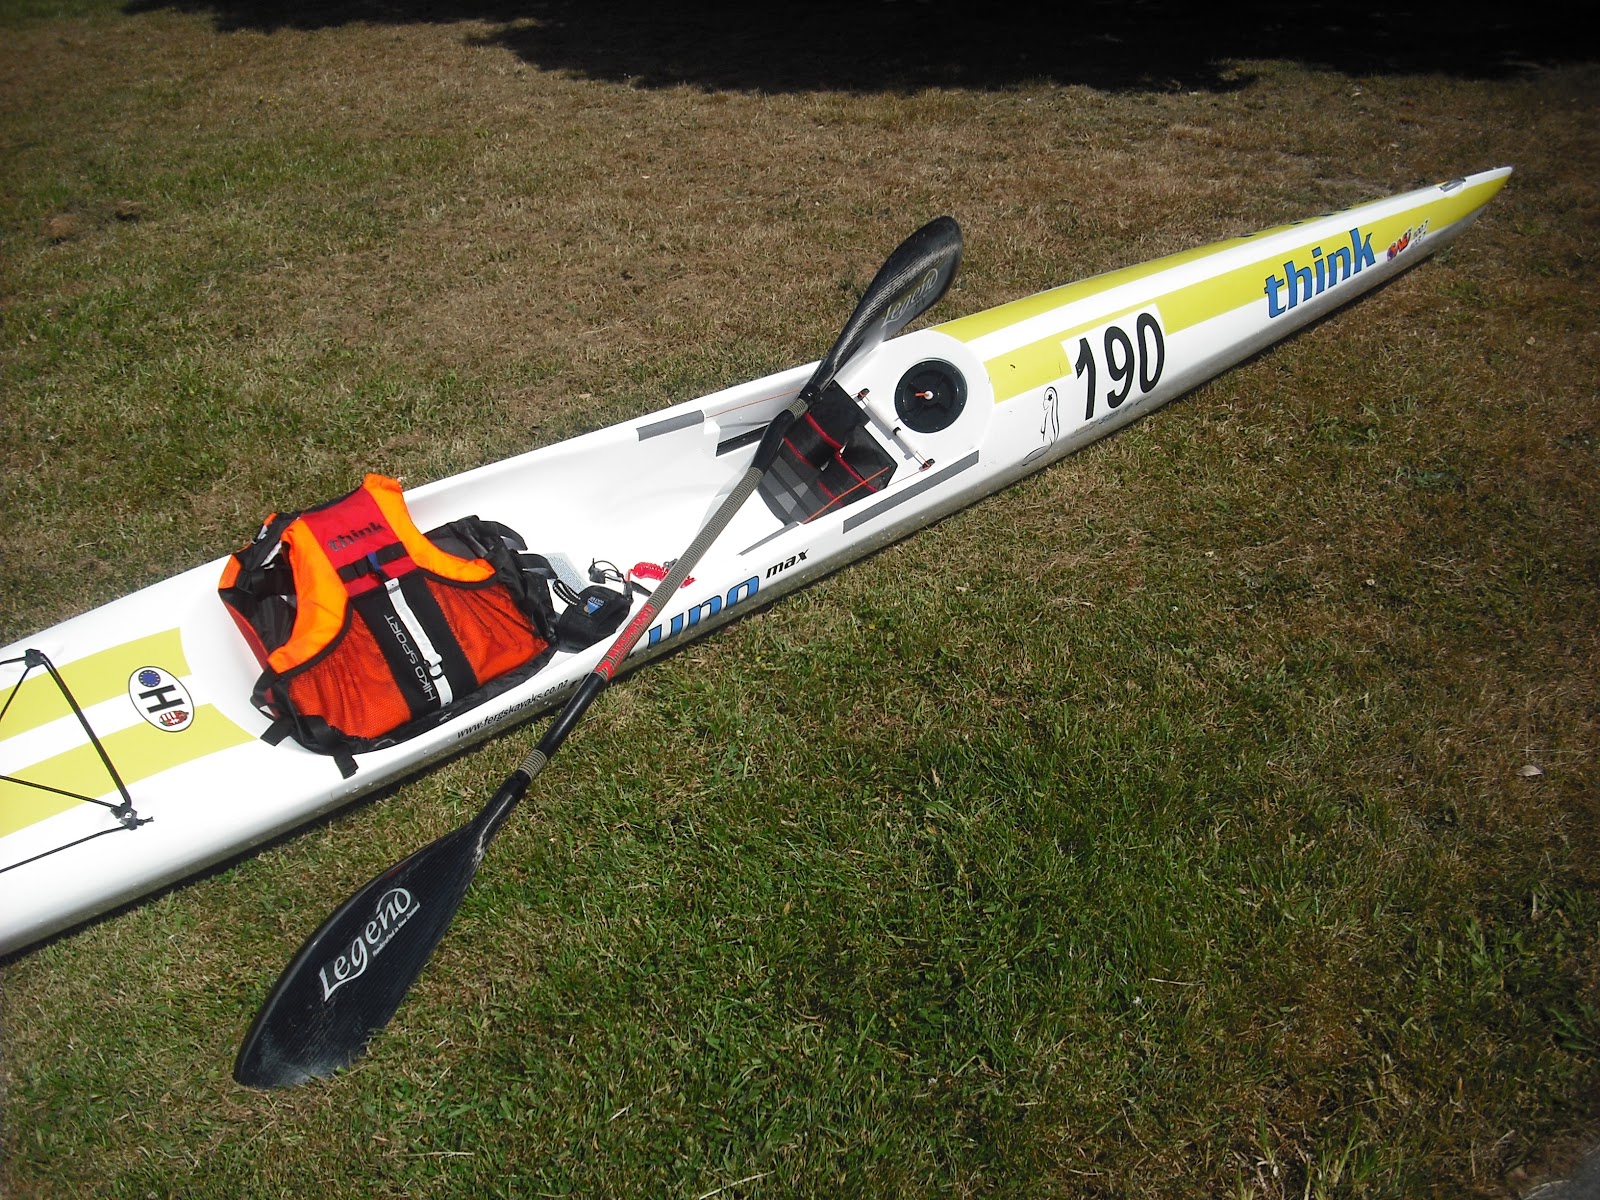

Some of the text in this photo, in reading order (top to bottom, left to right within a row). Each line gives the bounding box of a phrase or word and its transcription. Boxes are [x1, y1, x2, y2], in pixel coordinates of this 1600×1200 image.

[1263, 227, 1377, 319] think
[1074, 312, 1165, 421] 190
[328, 522, 387, 552] think
[765, 548, 810, 580] max
[383, 614, 437, 702] HIKO SPORT
[138, 684, 186, 714] H
[456, 679, 569, 739] www.fergskayaks.co.nz
